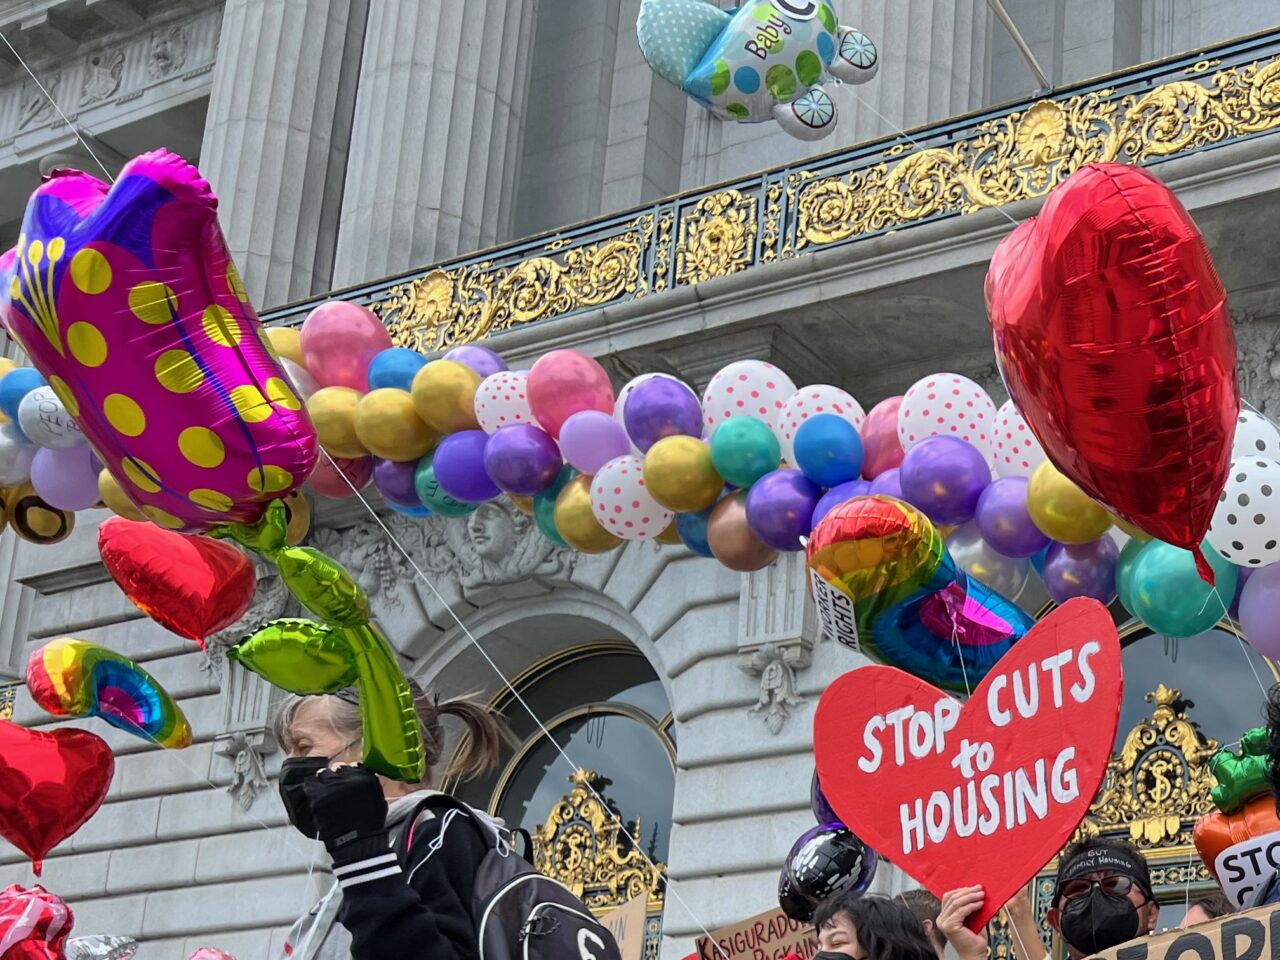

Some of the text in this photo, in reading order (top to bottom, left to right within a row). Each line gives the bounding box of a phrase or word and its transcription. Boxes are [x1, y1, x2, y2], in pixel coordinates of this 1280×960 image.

[744, 14, 792, 60] Baby
[831, 589, 857, 650] RIGHTS
[857, 641, 1100, 774] STOP CUTS
[952, 738, 994, 779] to
[900, 746, 1080, 855] HOUSING
